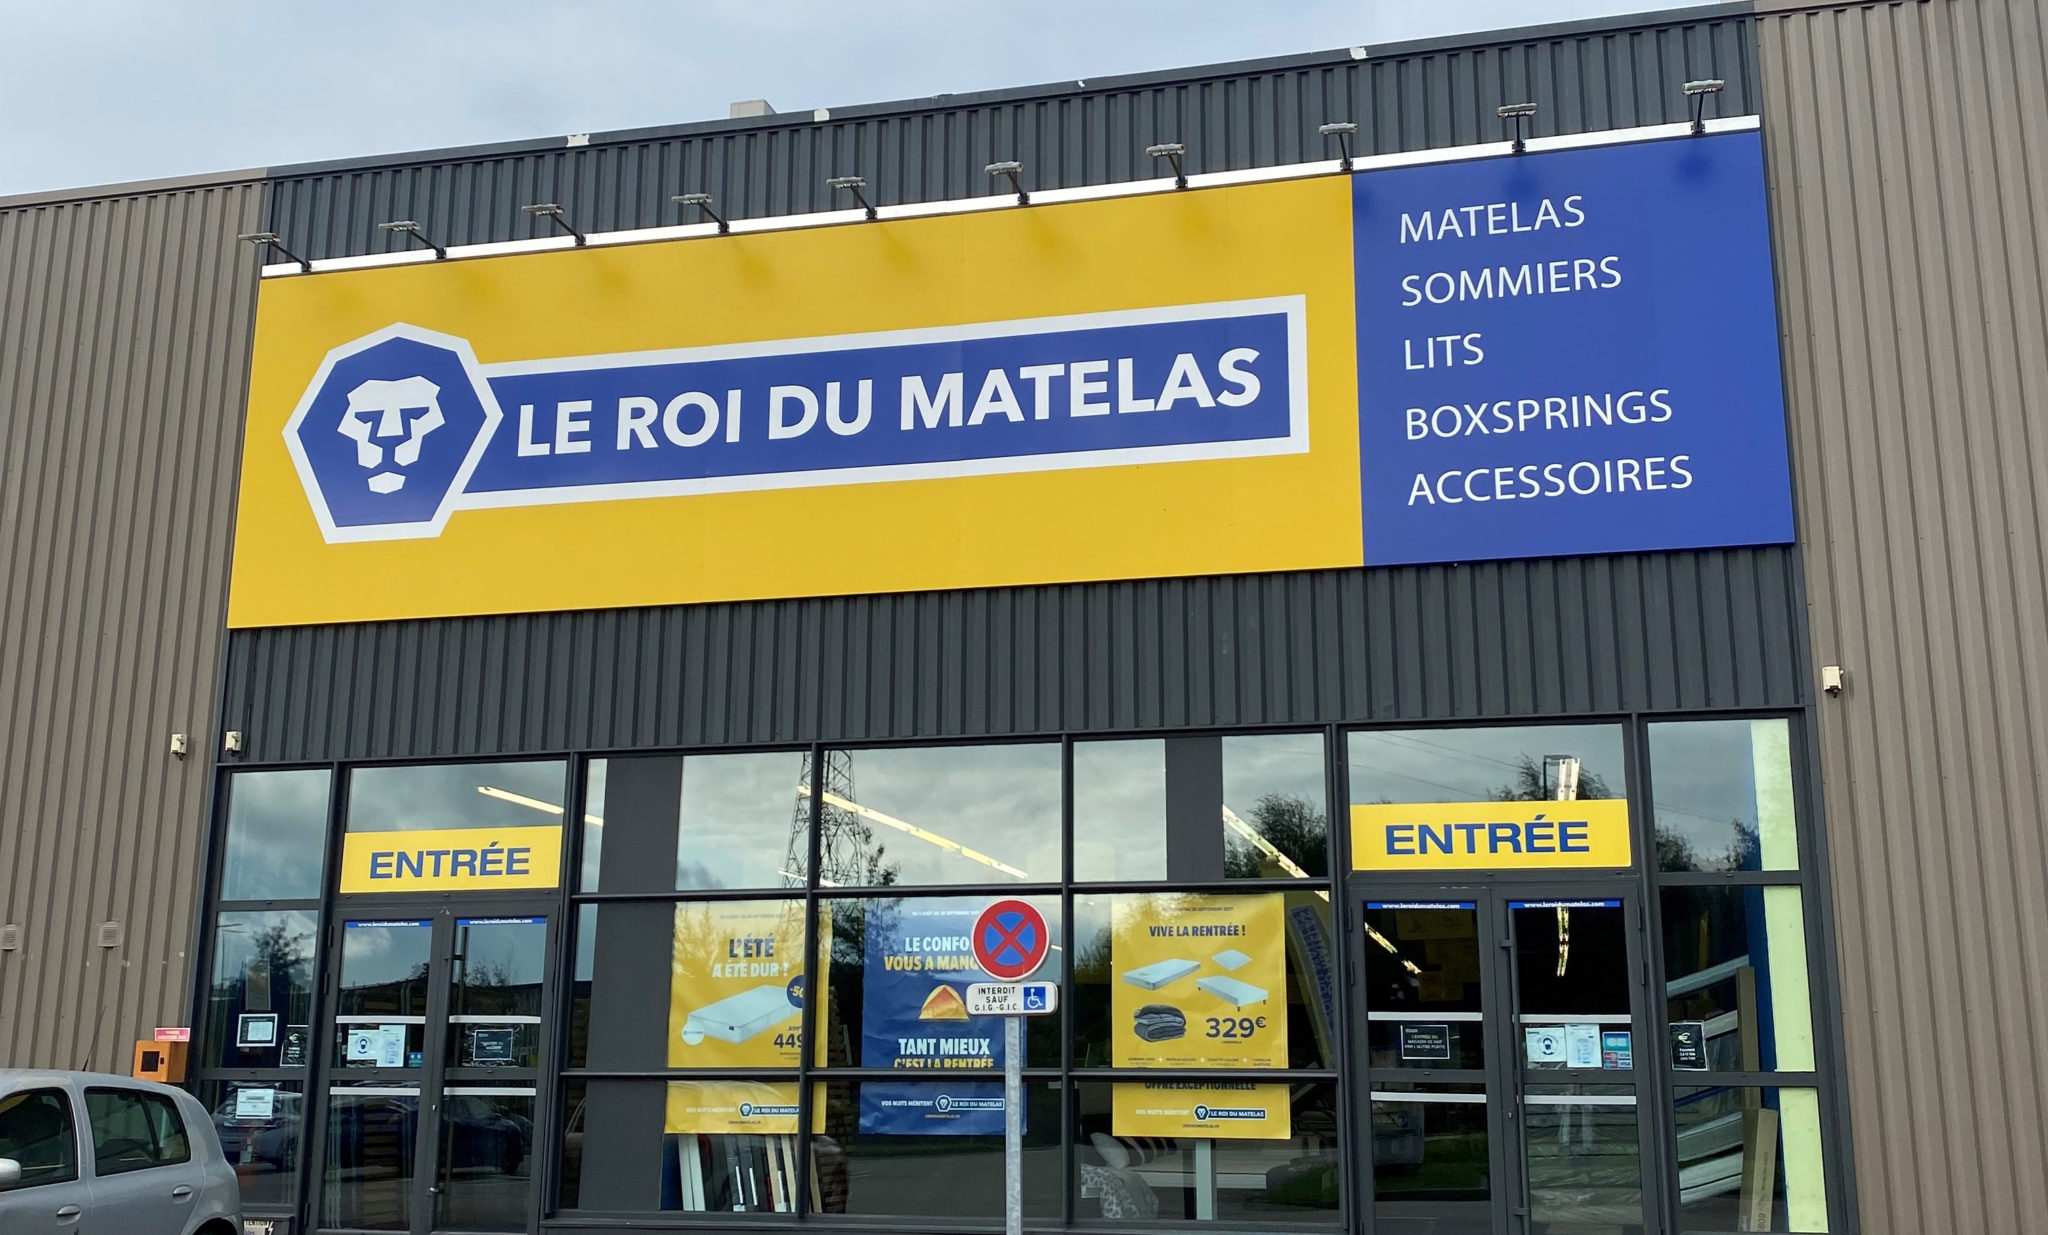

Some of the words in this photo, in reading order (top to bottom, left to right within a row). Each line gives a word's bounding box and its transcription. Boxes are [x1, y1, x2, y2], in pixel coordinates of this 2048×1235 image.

[1400, 195, 1585, 243] MATELAS
[1401, 256, 1622, 306] SOMMIERS
[1404, 333, 1484, 370] LITS
[517, 400, 592, 457] LE
[616, 389, 742, 451] ROI
[768, 379, 872, 440] DU
[900, 347, 1262, 431] MATELAS
[1405, 389, 1673, 440] BOXSPRINGS
[1407, 455, 1693, 506] ACCESSOIRES
[1385, 814, 1590, 855] ENTRÉE
[369, 842, 531, 879] ENTRÉE
[905, 937, 920, 951] LE
[923, 936, 972, 951] CONFO
[1149, 925, 1174, 937] VIVE
[1177, 925, 1189, 937] LA
[1192, 922, 1239, 936] RENTRÉE
[1242, 925, 1246, 936] !
[712, 962, 722, 978] A
[725, 959, 747, 978] ÉTÉ
[750, 961, 779, 977] DUR
[884, 956, 921, 971] VOUS
[924, 956, 934, 970] A
[899, 1038, 936, 1055] TANT
[940, 1038, 990, 1055] MIEUX
